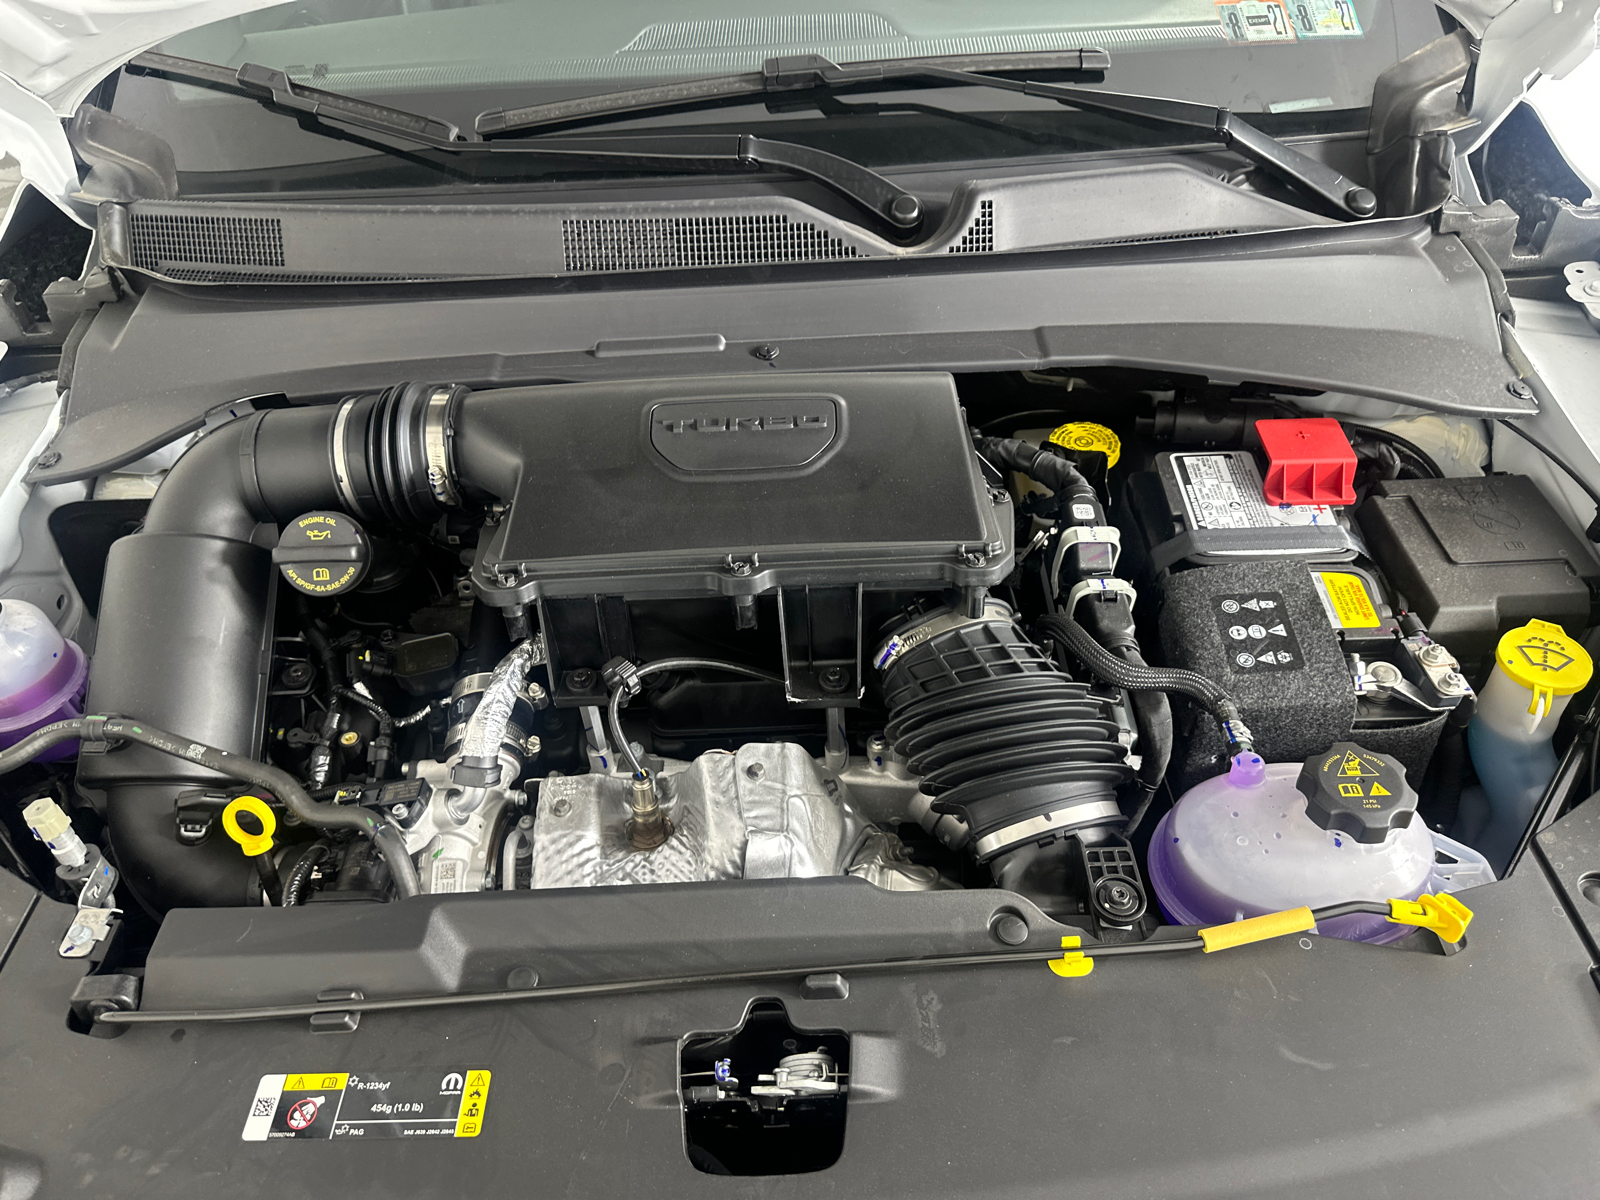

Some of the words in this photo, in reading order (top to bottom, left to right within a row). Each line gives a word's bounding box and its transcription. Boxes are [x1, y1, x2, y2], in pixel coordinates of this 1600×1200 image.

[1266, 4, 1288, 35] 27
[1296, 4, 1313, 31] 8
[655, 414, 829, 434] TURBO
[298, 516, 325, 528] ENGINE
[325, 517, 337, 527] OIL
[286, 569, 298, 581] API
[357, 1081, 391, 1091] R-1234yf
[370, 1103, 393, 1114] 454g
[393, 1102, 410, 1114] (1.0
[411, 1102, 424, 1114] lb)
[349, 1128, 365, 1136] PAG
